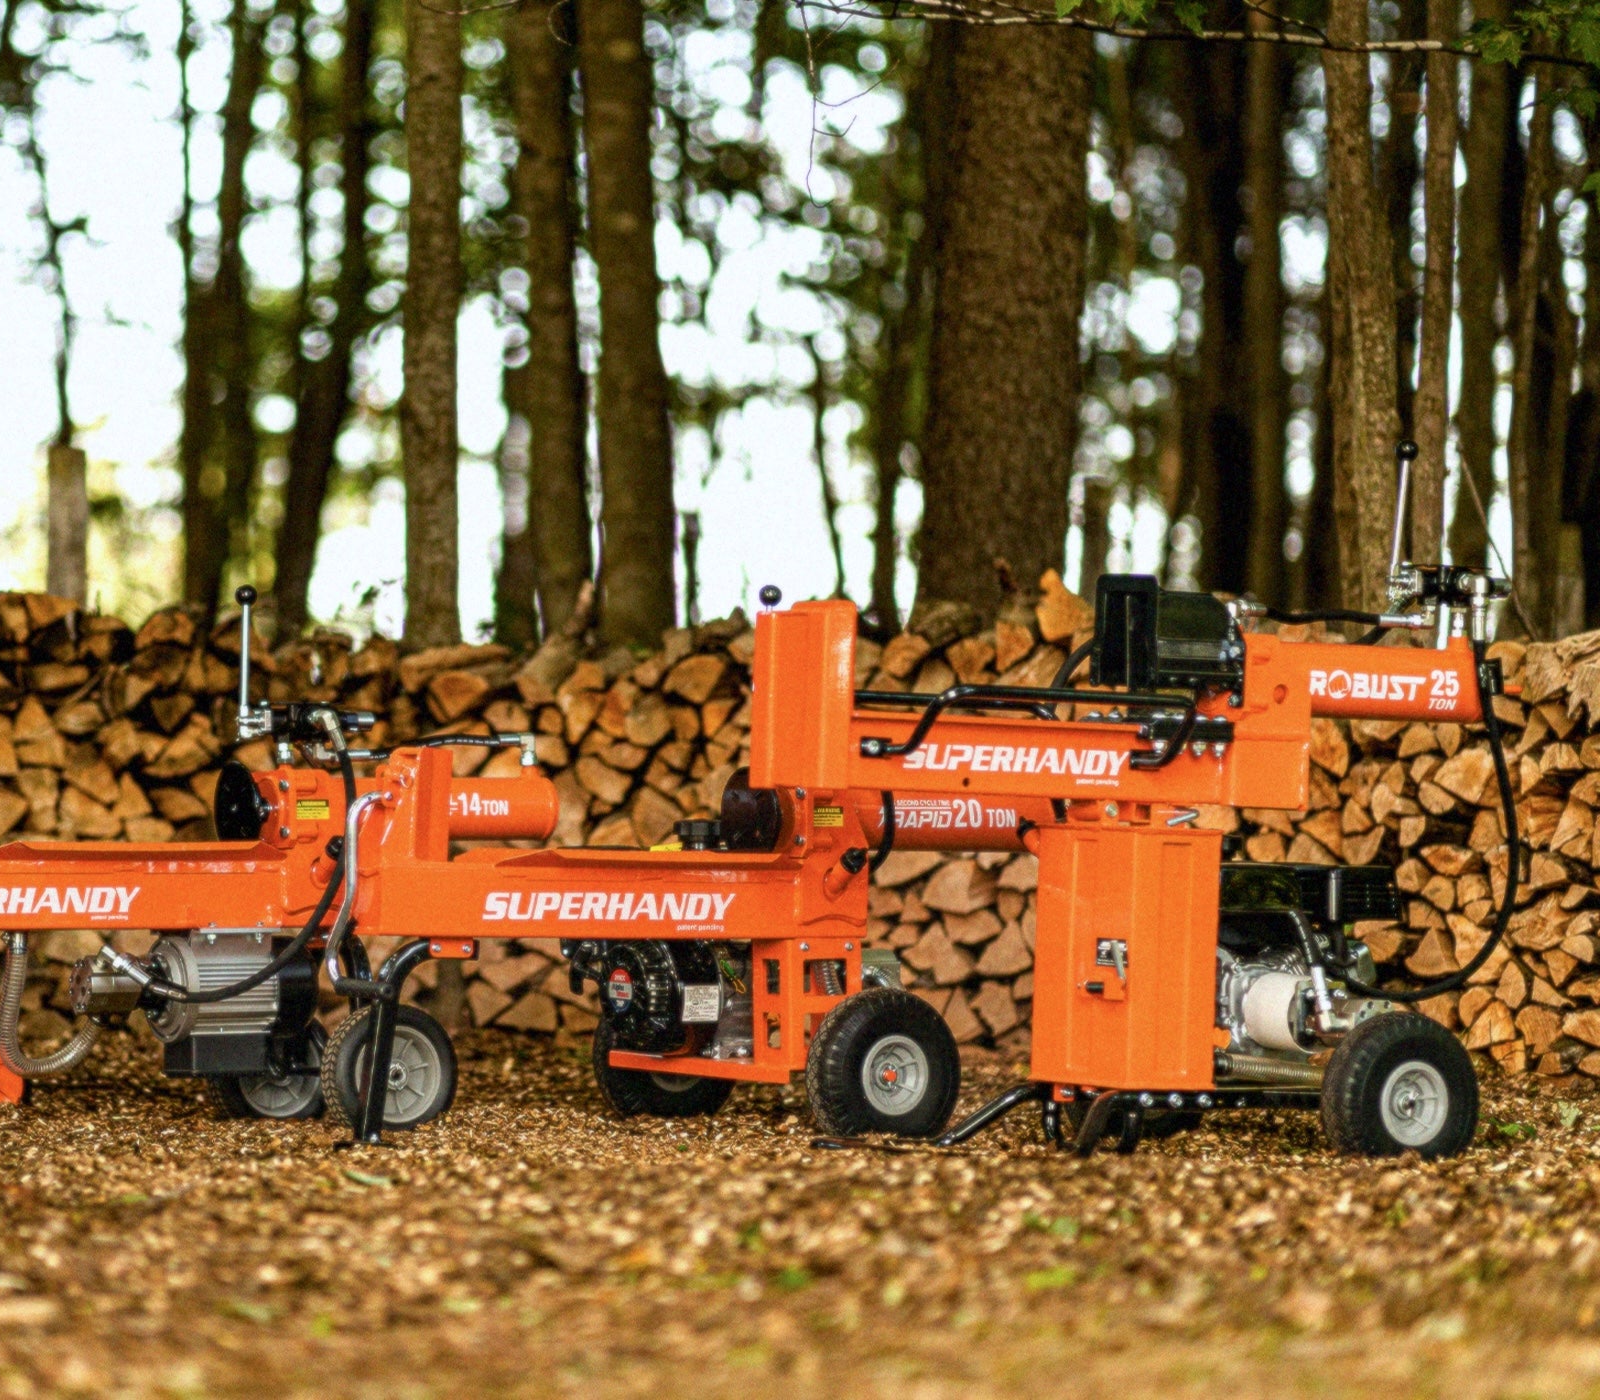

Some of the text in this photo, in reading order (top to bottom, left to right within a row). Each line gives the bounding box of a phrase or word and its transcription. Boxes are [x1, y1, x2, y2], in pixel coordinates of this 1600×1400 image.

[1309, 669, 1460, 701] ROBUST 25
[1428, 698, 1457, 710] TON
[902, 743, 1129, 776] SUPERHANDY
[952, 798, 982, 828] 20
[986, 808, 1016, 828] TON
[482, 892, 736, 921] SUPERHANDY
